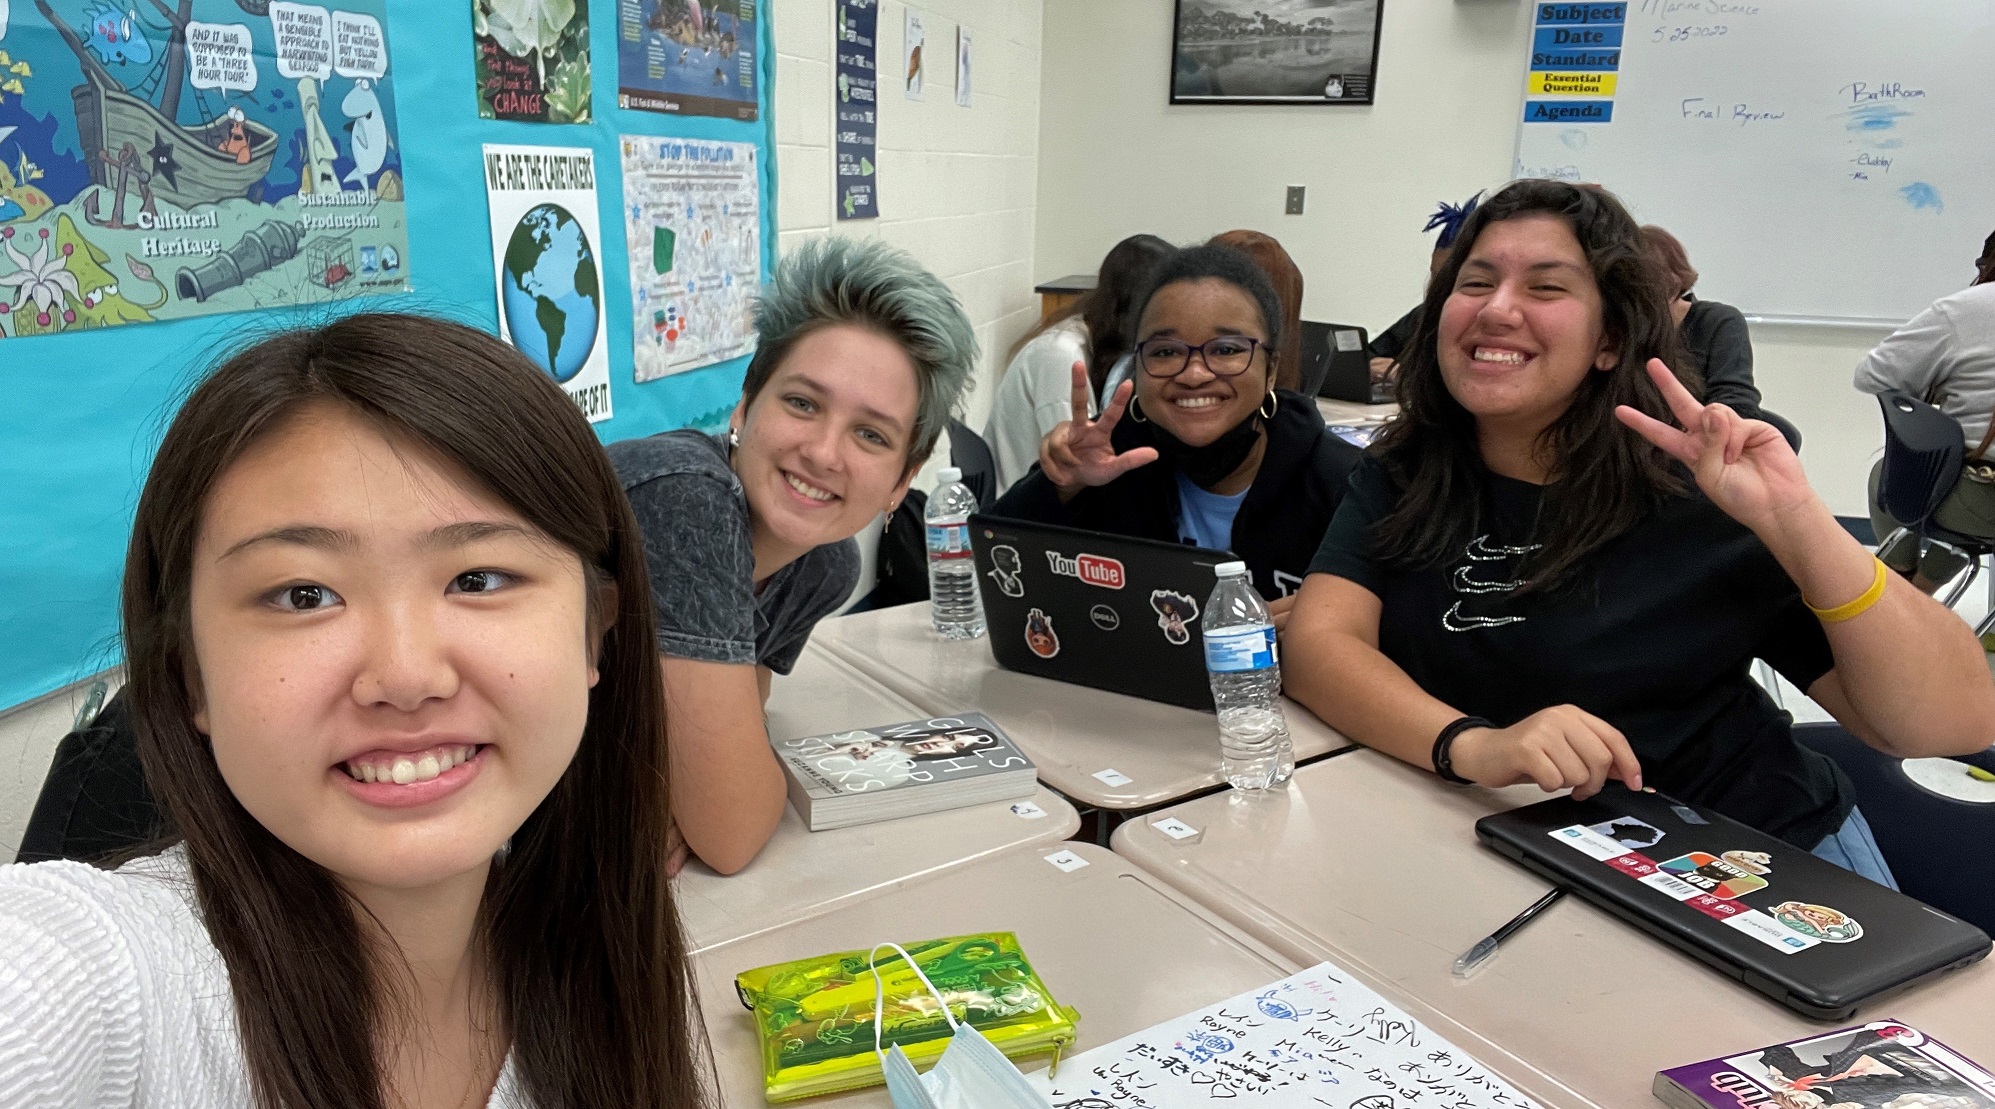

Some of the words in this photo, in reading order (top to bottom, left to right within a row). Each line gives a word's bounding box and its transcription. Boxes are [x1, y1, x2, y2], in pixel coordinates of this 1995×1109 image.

[1540, 4, 1624, 24] Subject
[192, 28, 210, 41] AND
[213, 31, 220, 42] IT
[223, 32, 239, 44] WAS
[1554, 28, 1604, 44] Date
[192, 41, 235, 56] SUPPOSED
[237, 46, 247, 57] TO
[196, 55, 207, 67] BE
[1532, 50, 1619, 66] Standard
[198, 68, 221, 81] HOUR
[1544, 73, 1601, 82] Essential
[1543, 83, 1599, 93] Question
[494, 91, 542, 114] CHANGE
[1682, 98, 1720, 118] Final
[1534, 104, 1603, 119] Agenda
[486, 153, 505, 191] WE
[505, 153, 525, 191] ARE
[524, 154, 544, 191] THE
[543, 154, 594, 191] CARETAKERS
[297, 190, 377, 207] Sustainable
[137, 211, 218, 229] Cultural
[303, 213, 380, 229] Production
[141, 236, 221, 257] Heritage
[569, 388, 588, 417] ARE
[589, 385, 598, 416] OF
[600, 383, 608, 413] IT
[885, 724, 978, 773] WITH
[927, 717, 1026, 769] GIRLS
[1710, 861, 1749, 878] GOOD
[1677, 871, 1715, 889] JOB
[1302, 1026, 1350, 1052] Kelly
[1275, 1039, 1313, 1060] Mia
